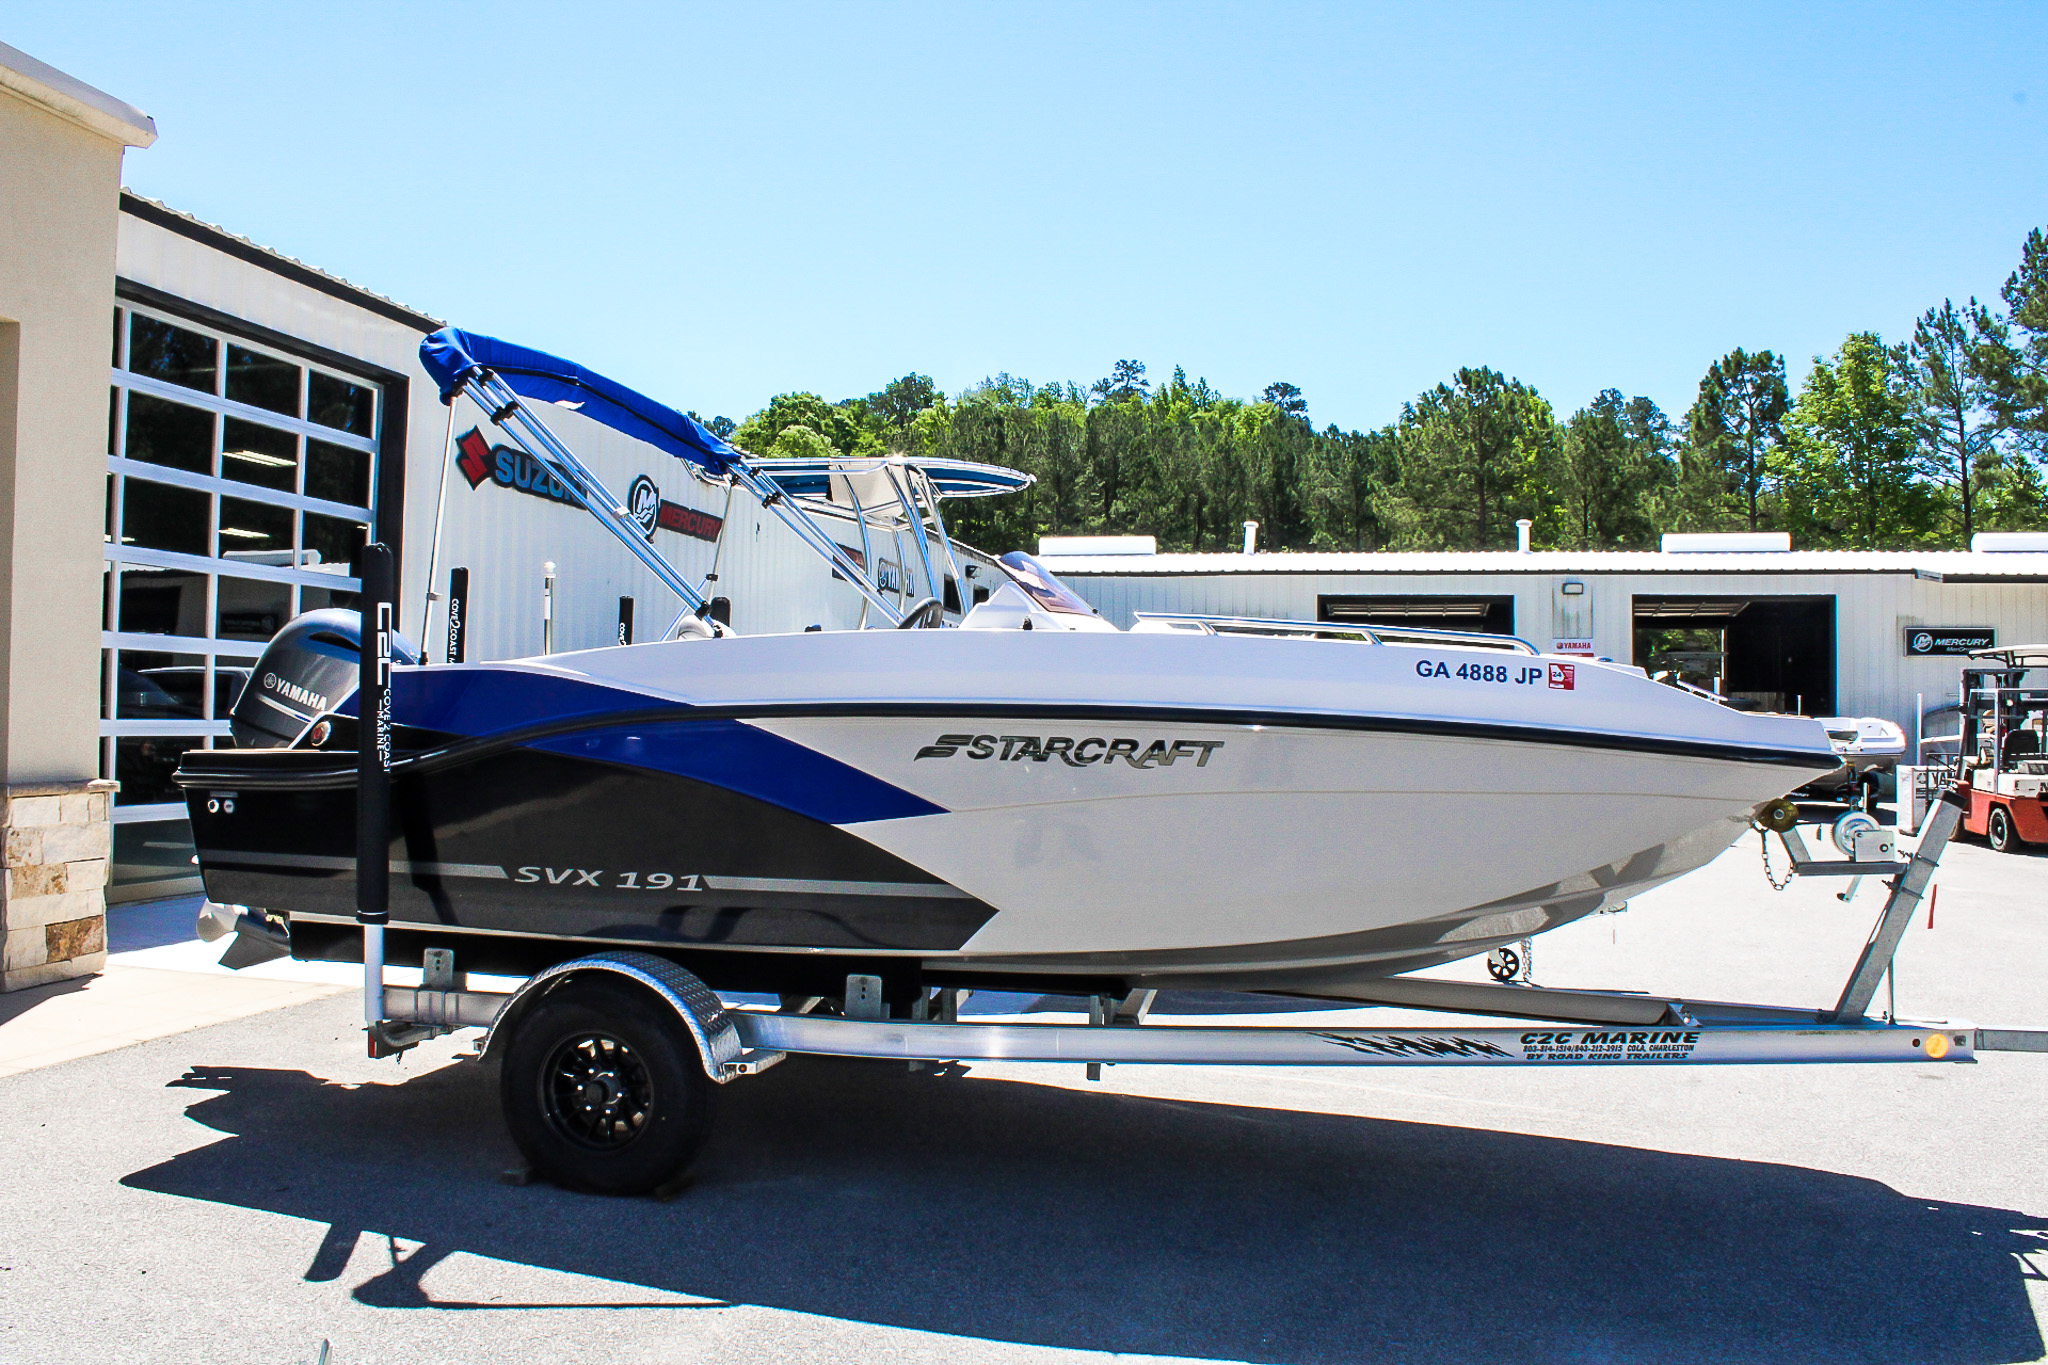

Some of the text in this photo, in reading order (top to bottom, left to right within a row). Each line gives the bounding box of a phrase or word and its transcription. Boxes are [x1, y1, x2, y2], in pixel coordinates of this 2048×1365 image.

[661, 504, 720, 538] MERCURY
[1935, 638, 1990, 646] MERCURY
[1416, 660, 1543, 685] GA 4888 JP
[276, 677, 328, 712] YAMAHA
[376, 710, 385, 751] MARINE
[383, 688, 392, 773] COVE 2 COAST
[967, 734, 1225, 770] STARCRAFT
[514, 866, 702, 892] SVX 191
[1520, 1031, 1701, 1045] C2C MARINE
[1627, 1052, 1689, 1060] TRAILERS
